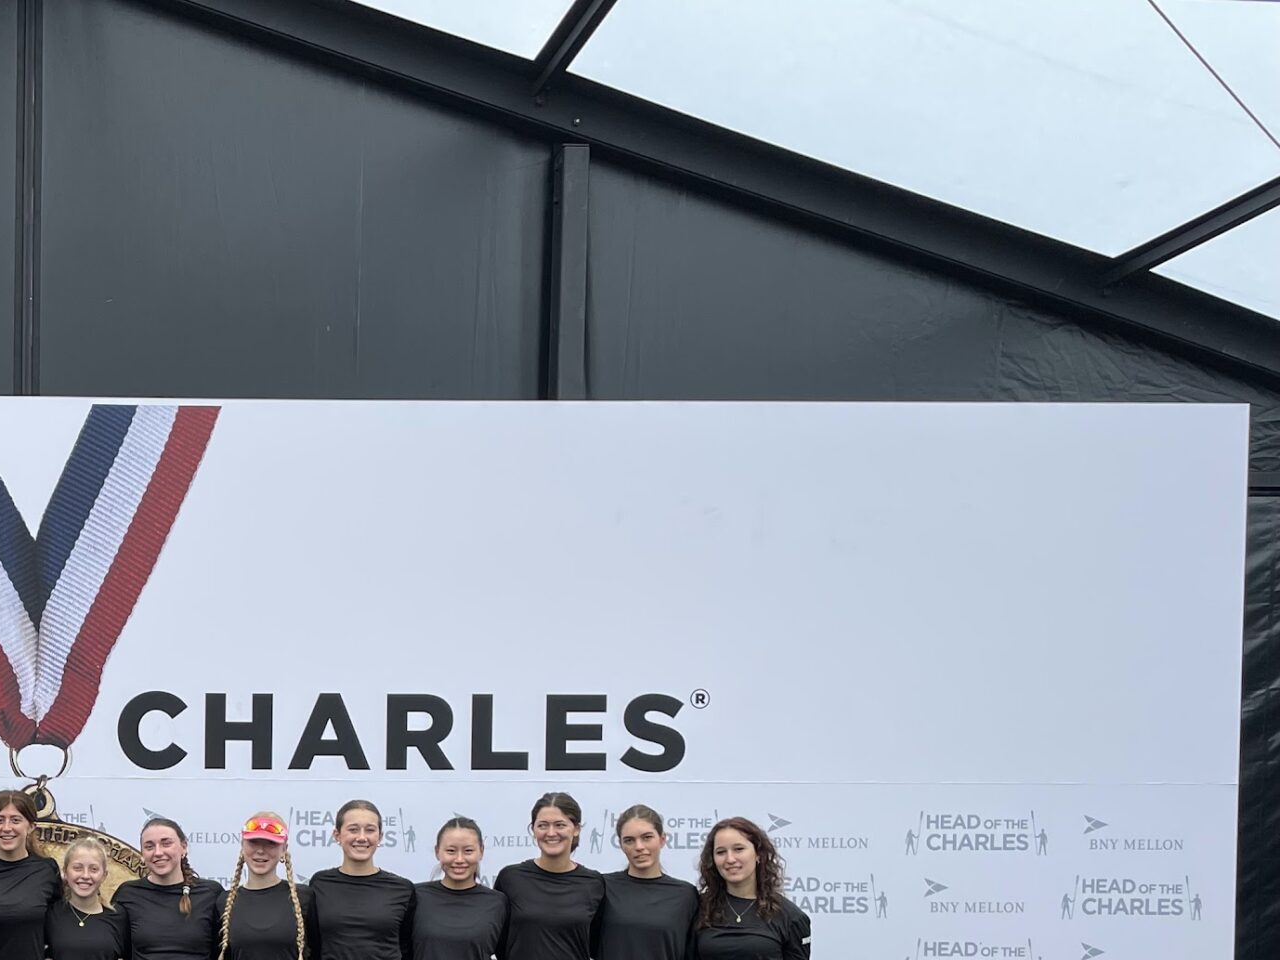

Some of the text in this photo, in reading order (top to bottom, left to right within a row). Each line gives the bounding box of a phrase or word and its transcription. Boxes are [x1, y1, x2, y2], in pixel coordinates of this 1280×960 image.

[63, 813, 88, 824] THE
[295, 810, 335, 826] HEA
[667, 817, 713, 829] OF THE
[926, 814, 1028, 830] HEAD OF THE
[493, 835, 537, 848] MELL
[773, 837, 869, 849] BNY MELLON
[926, 833, 1029, 851] CHARLES
[1089, 838, 1184, 850] BNY MELLON
[783, 877, 868, 893] EAD OF THE
[1082, 878, 1183, 894] HEAD OF THE
[793, 896, 869, 914] ARLES
[930, 902, 1024, 913] BNY MELLON
[1082, 897, 1184, 916] CHARLES
[924, 941, 1025, 957] HEAD OF THE
